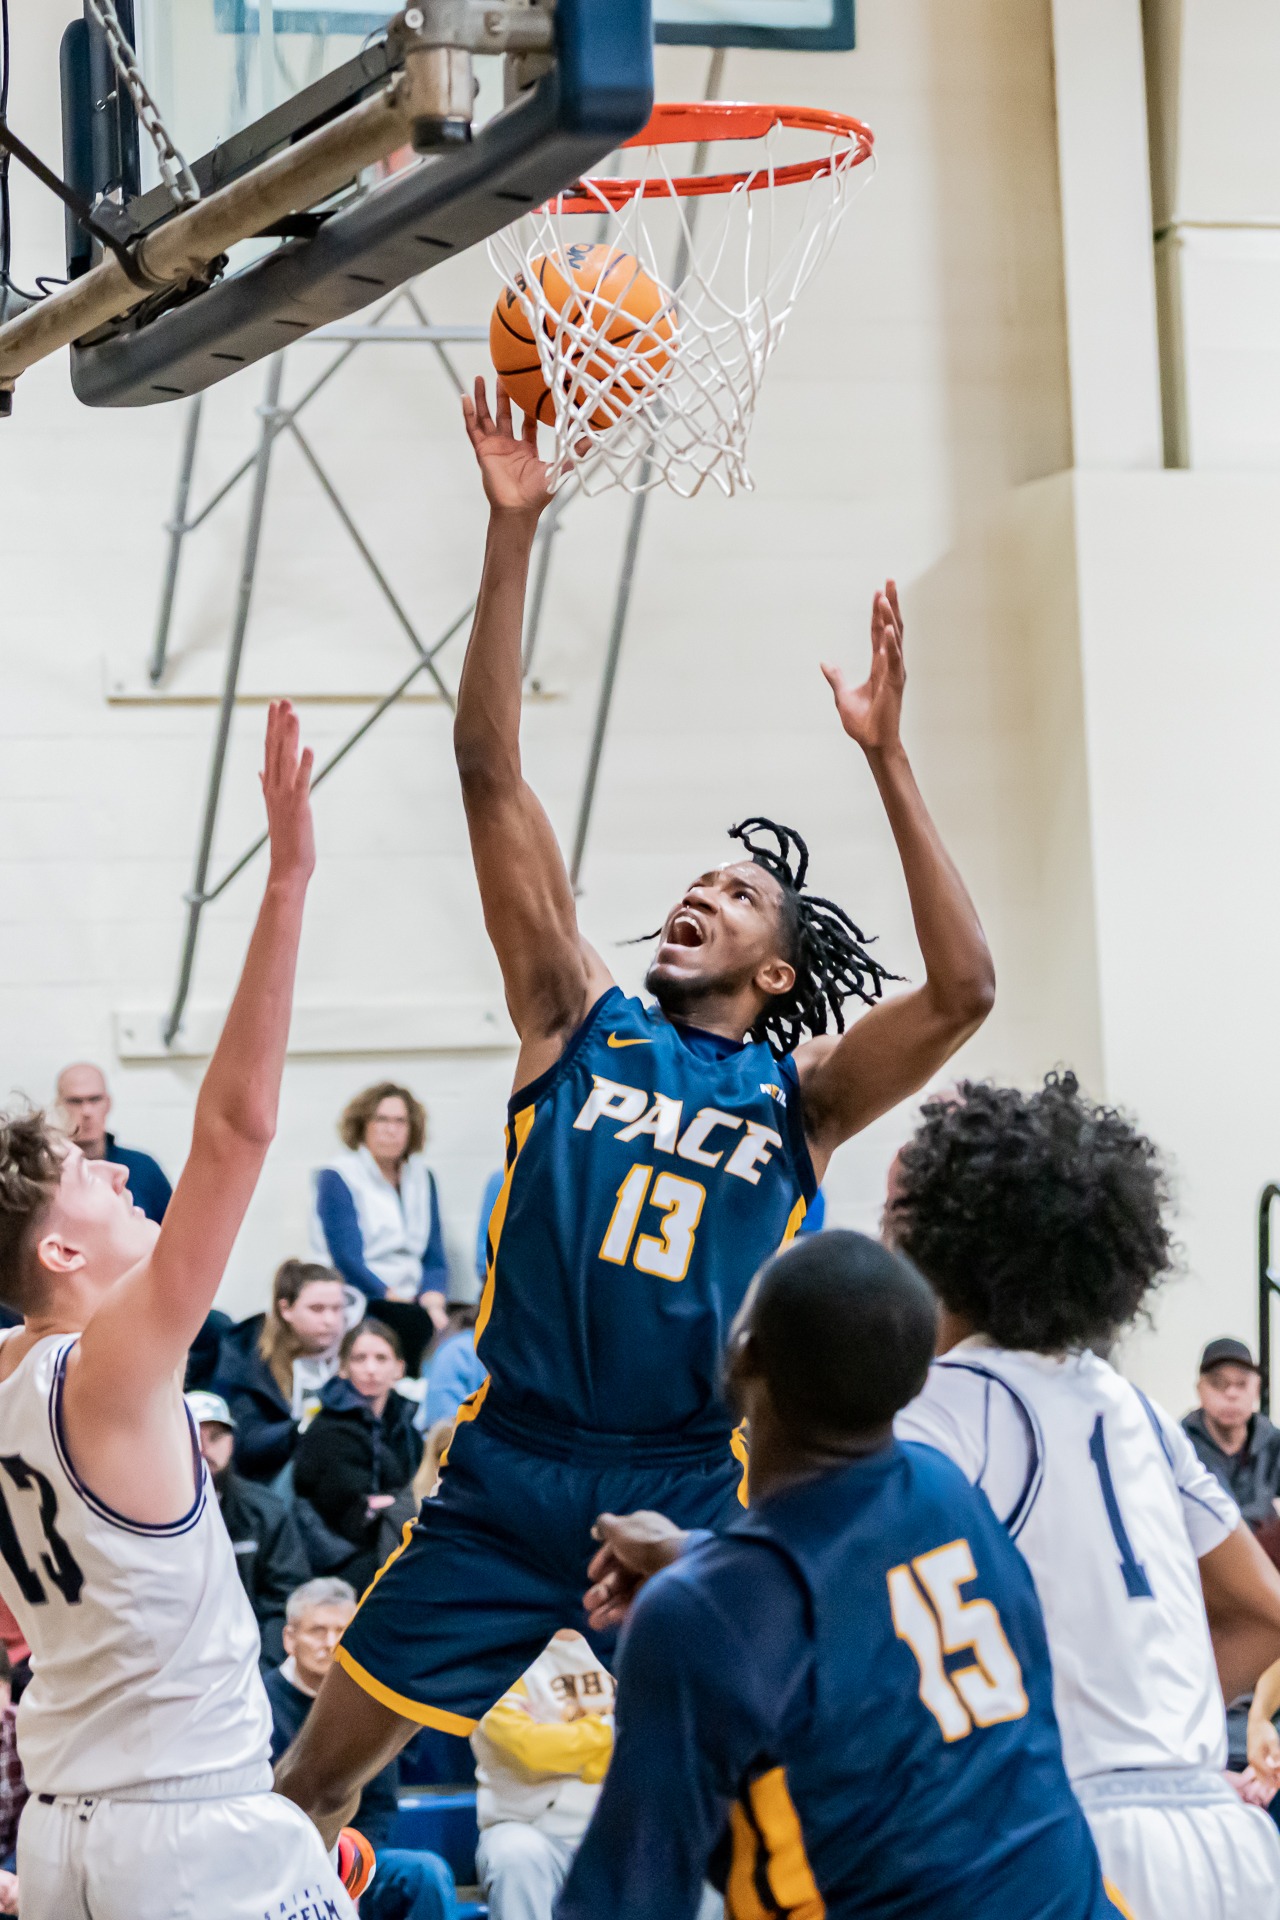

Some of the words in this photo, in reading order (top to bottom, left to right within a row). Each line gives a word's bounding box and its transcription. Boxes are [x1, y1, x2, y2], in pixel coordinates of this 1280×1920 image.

[573, 1075, 783, 1185] PACE
[598, 1163, 706, 1282] 13
[1089, 1412, 1155, 1600] 1
[886, 1538, 1029, 1743] 15
